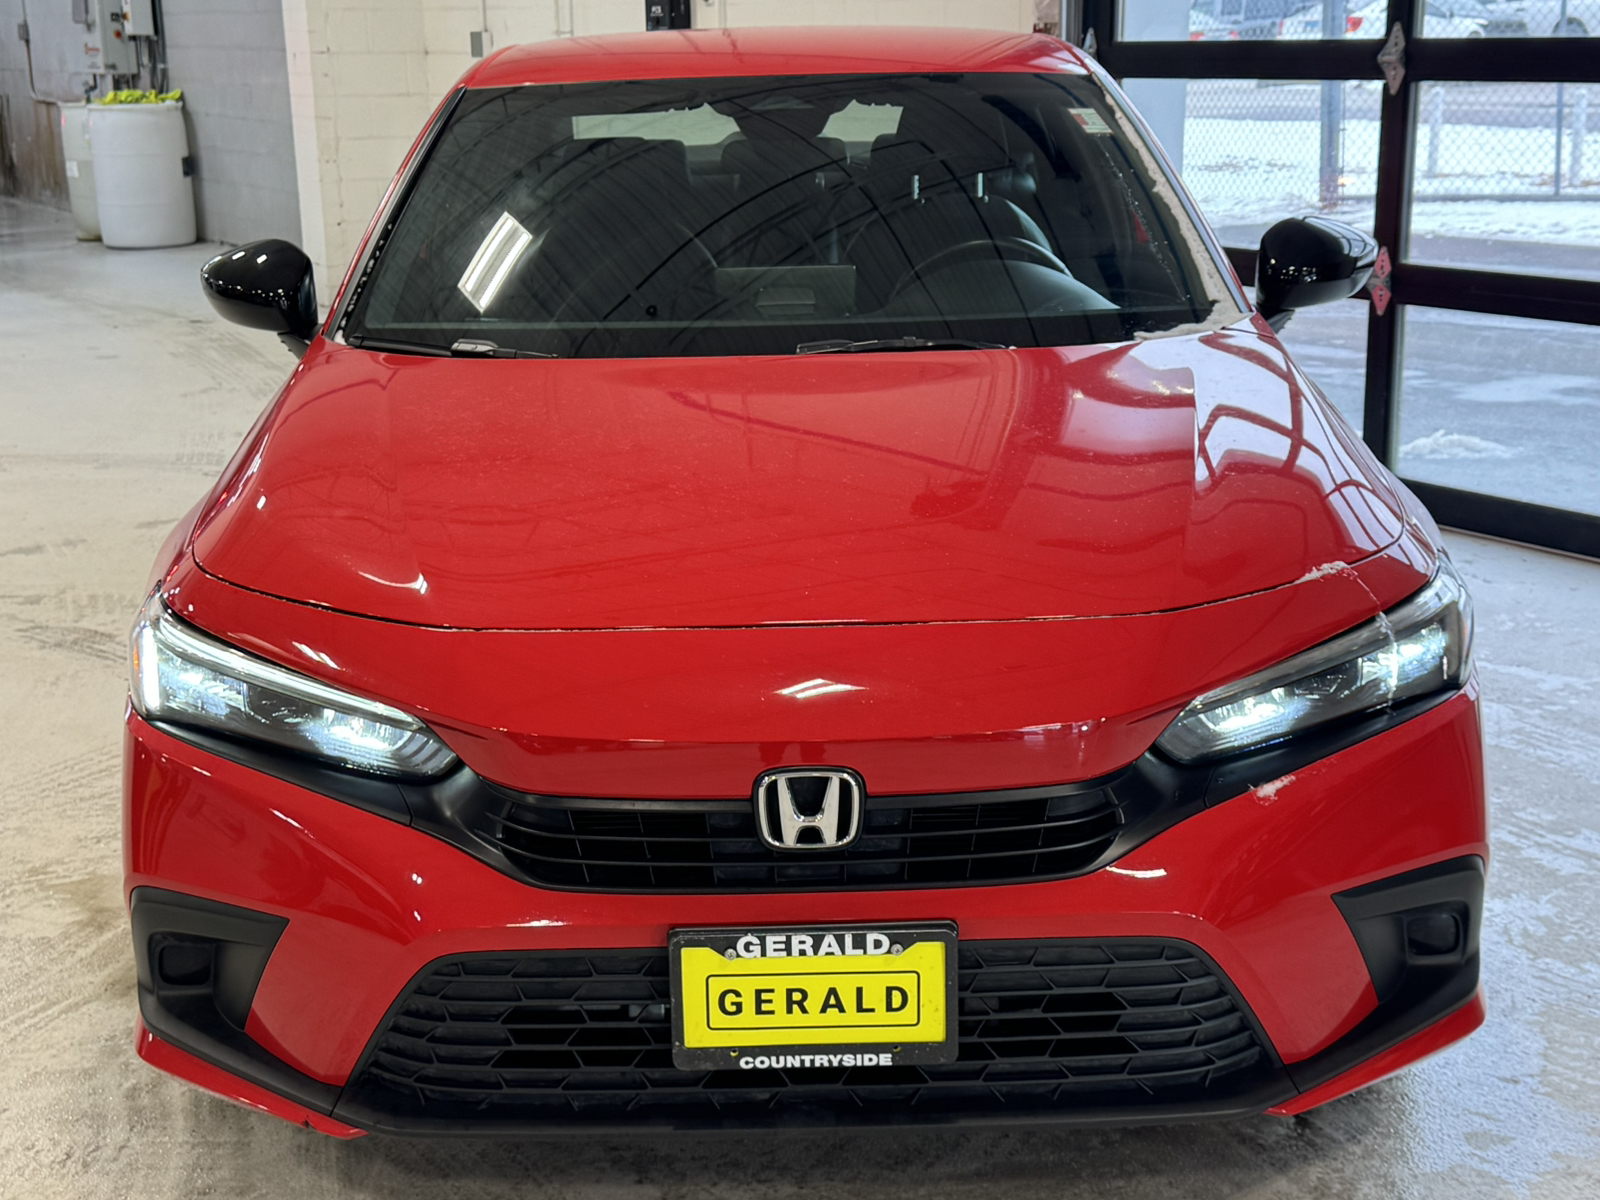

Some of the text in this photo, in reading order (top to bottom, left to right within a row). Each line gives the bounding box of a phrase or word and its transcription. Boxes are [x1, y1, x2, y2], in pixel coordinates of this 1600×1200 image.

[736, 933, 891, 958] GERALD
[717, 985, 909, 1016] GERALD
[739, 1052, 893, 1070] COUNTRYSIDE
